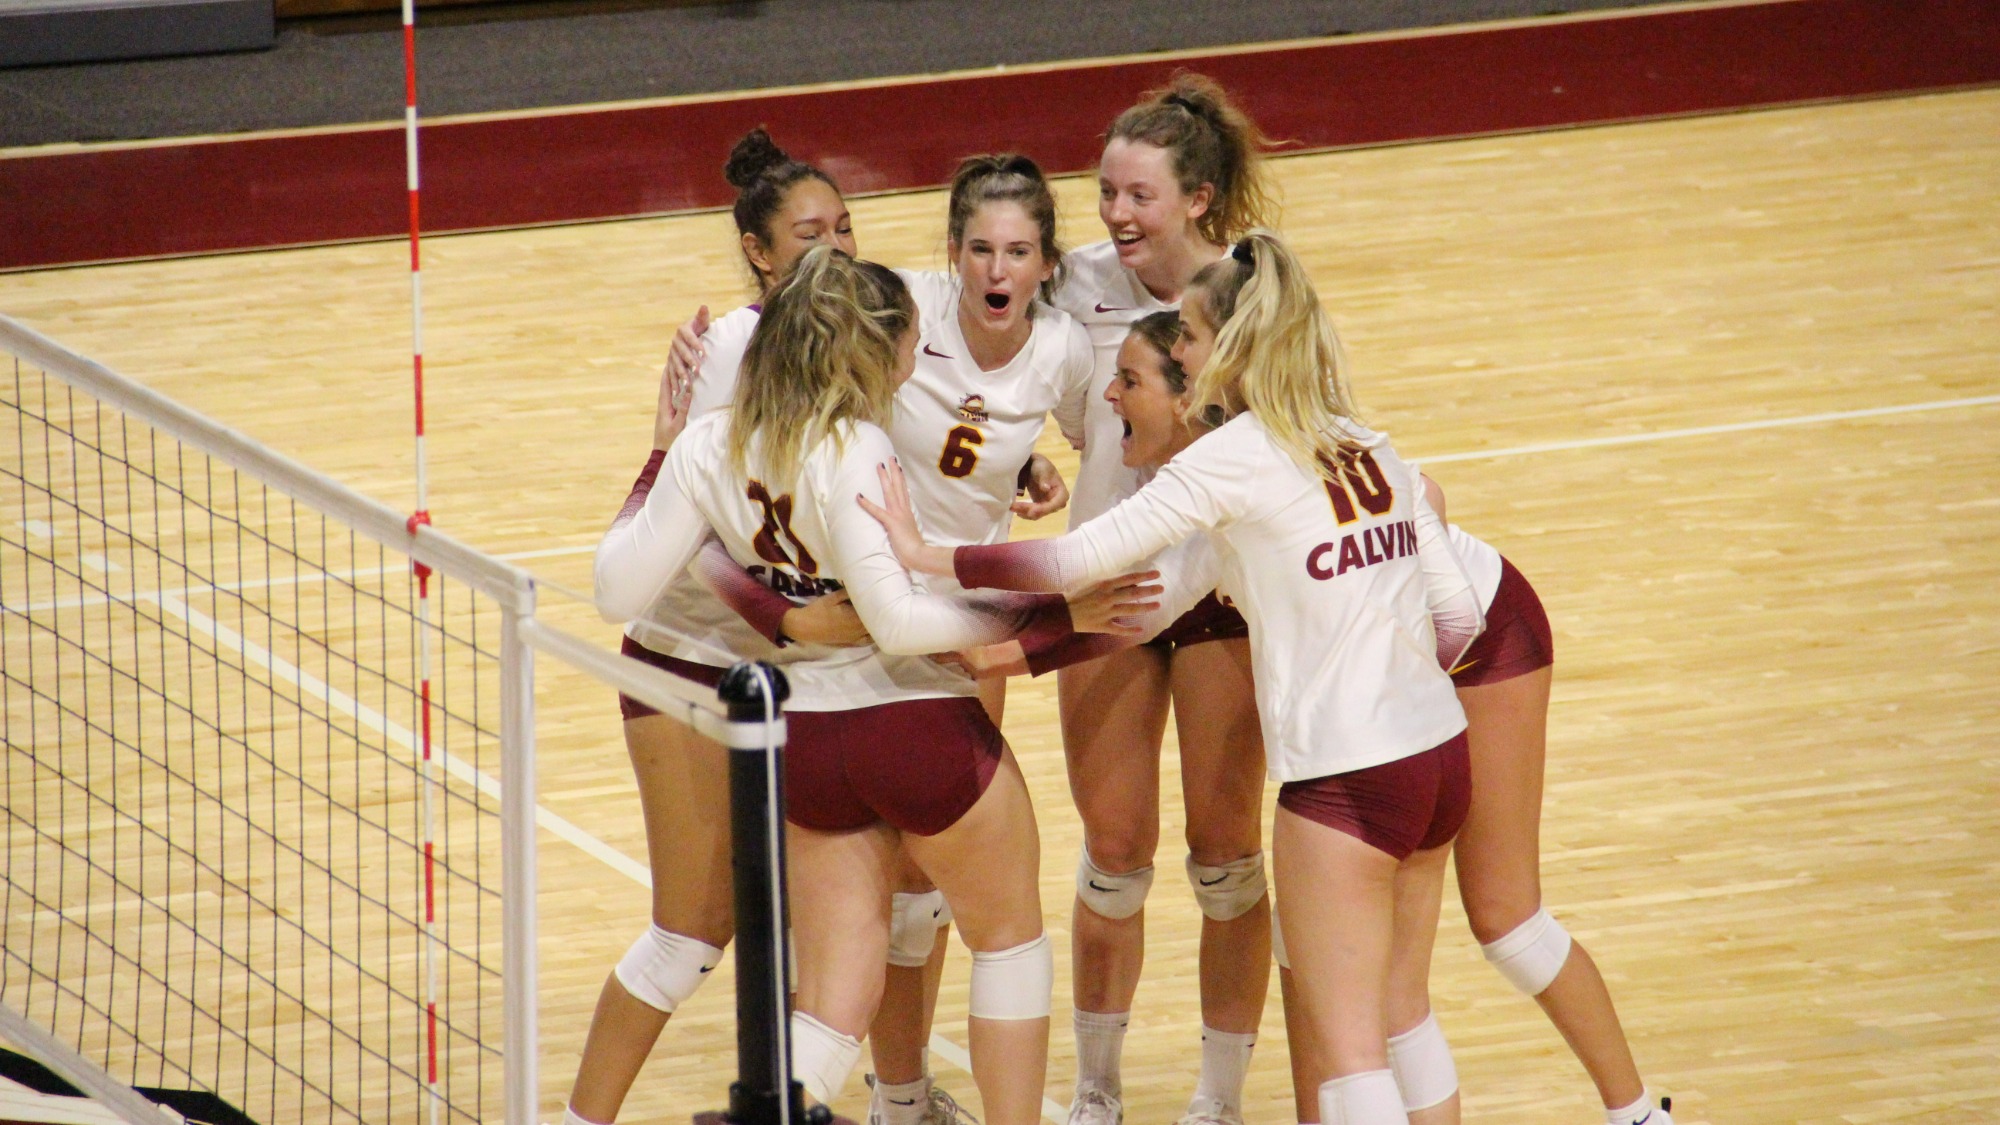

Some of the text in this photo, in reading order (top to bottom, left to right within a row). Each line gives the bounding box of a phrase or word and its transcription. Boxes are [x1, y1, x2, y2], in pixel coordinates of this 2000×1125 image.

[937, 423, 985, 479] 6
[1315, 440, 1394, 527] 10
[1306, 520, 1419, 581] CALVIN
